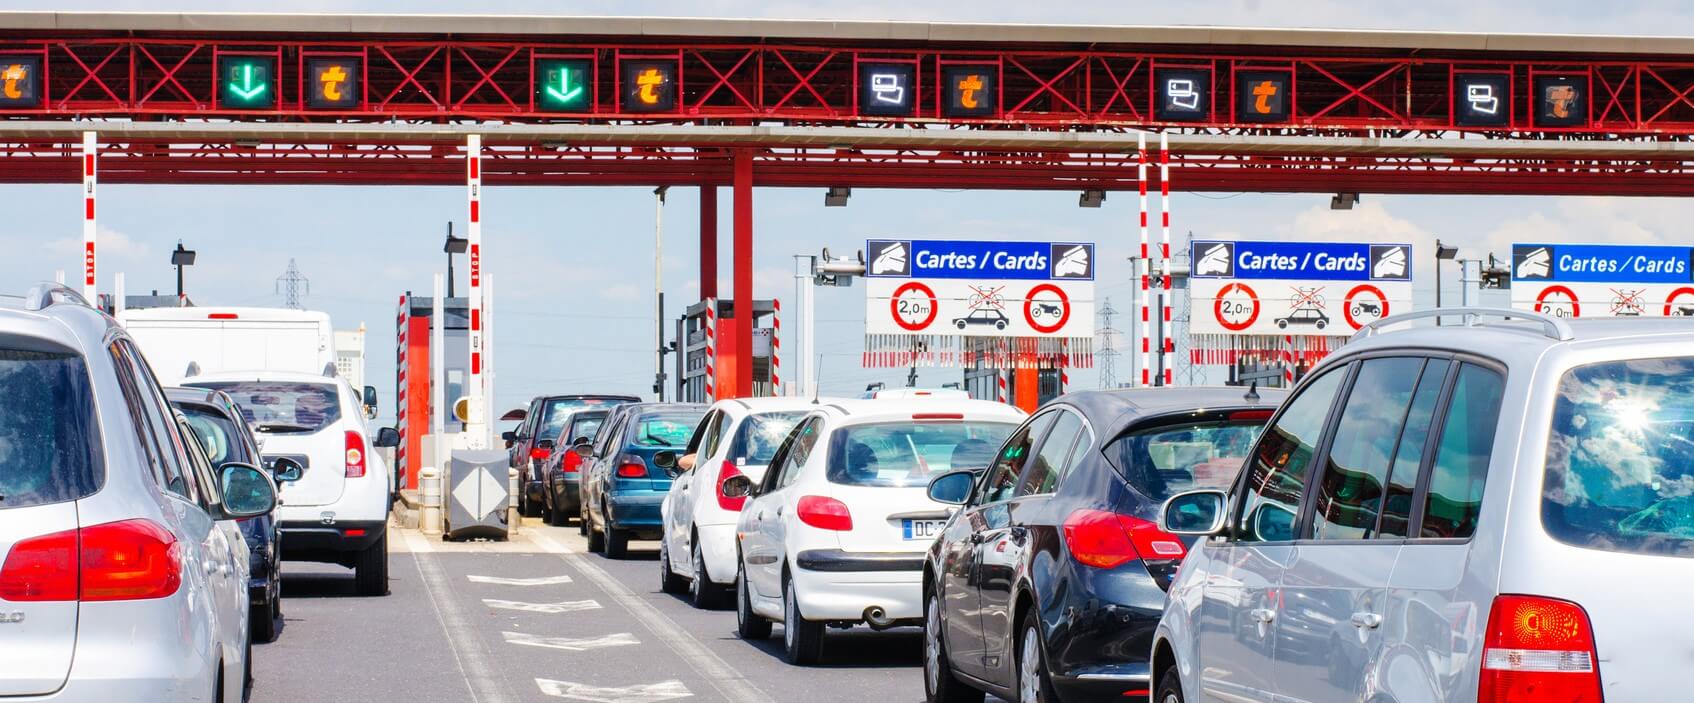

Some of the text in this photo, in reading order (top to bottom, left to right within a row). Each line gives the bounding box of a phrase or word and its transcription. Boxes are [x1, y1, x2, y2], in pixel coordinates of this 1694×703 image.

[86, 250, 94, 278] STOP
[471, 253, 479, 280] STOP
[915, 250, 976, 270] Cartes
[993, 251, 1047, 271] Cards
[1238, 251, 1298, 271] Cartes
[1313, 252, 1366, 272] Cards
[1559, 254, 1618, 273] Cartes
[1633, 256, 1686, 274] Cards
[1542, 305, 1573, 318] 20m
